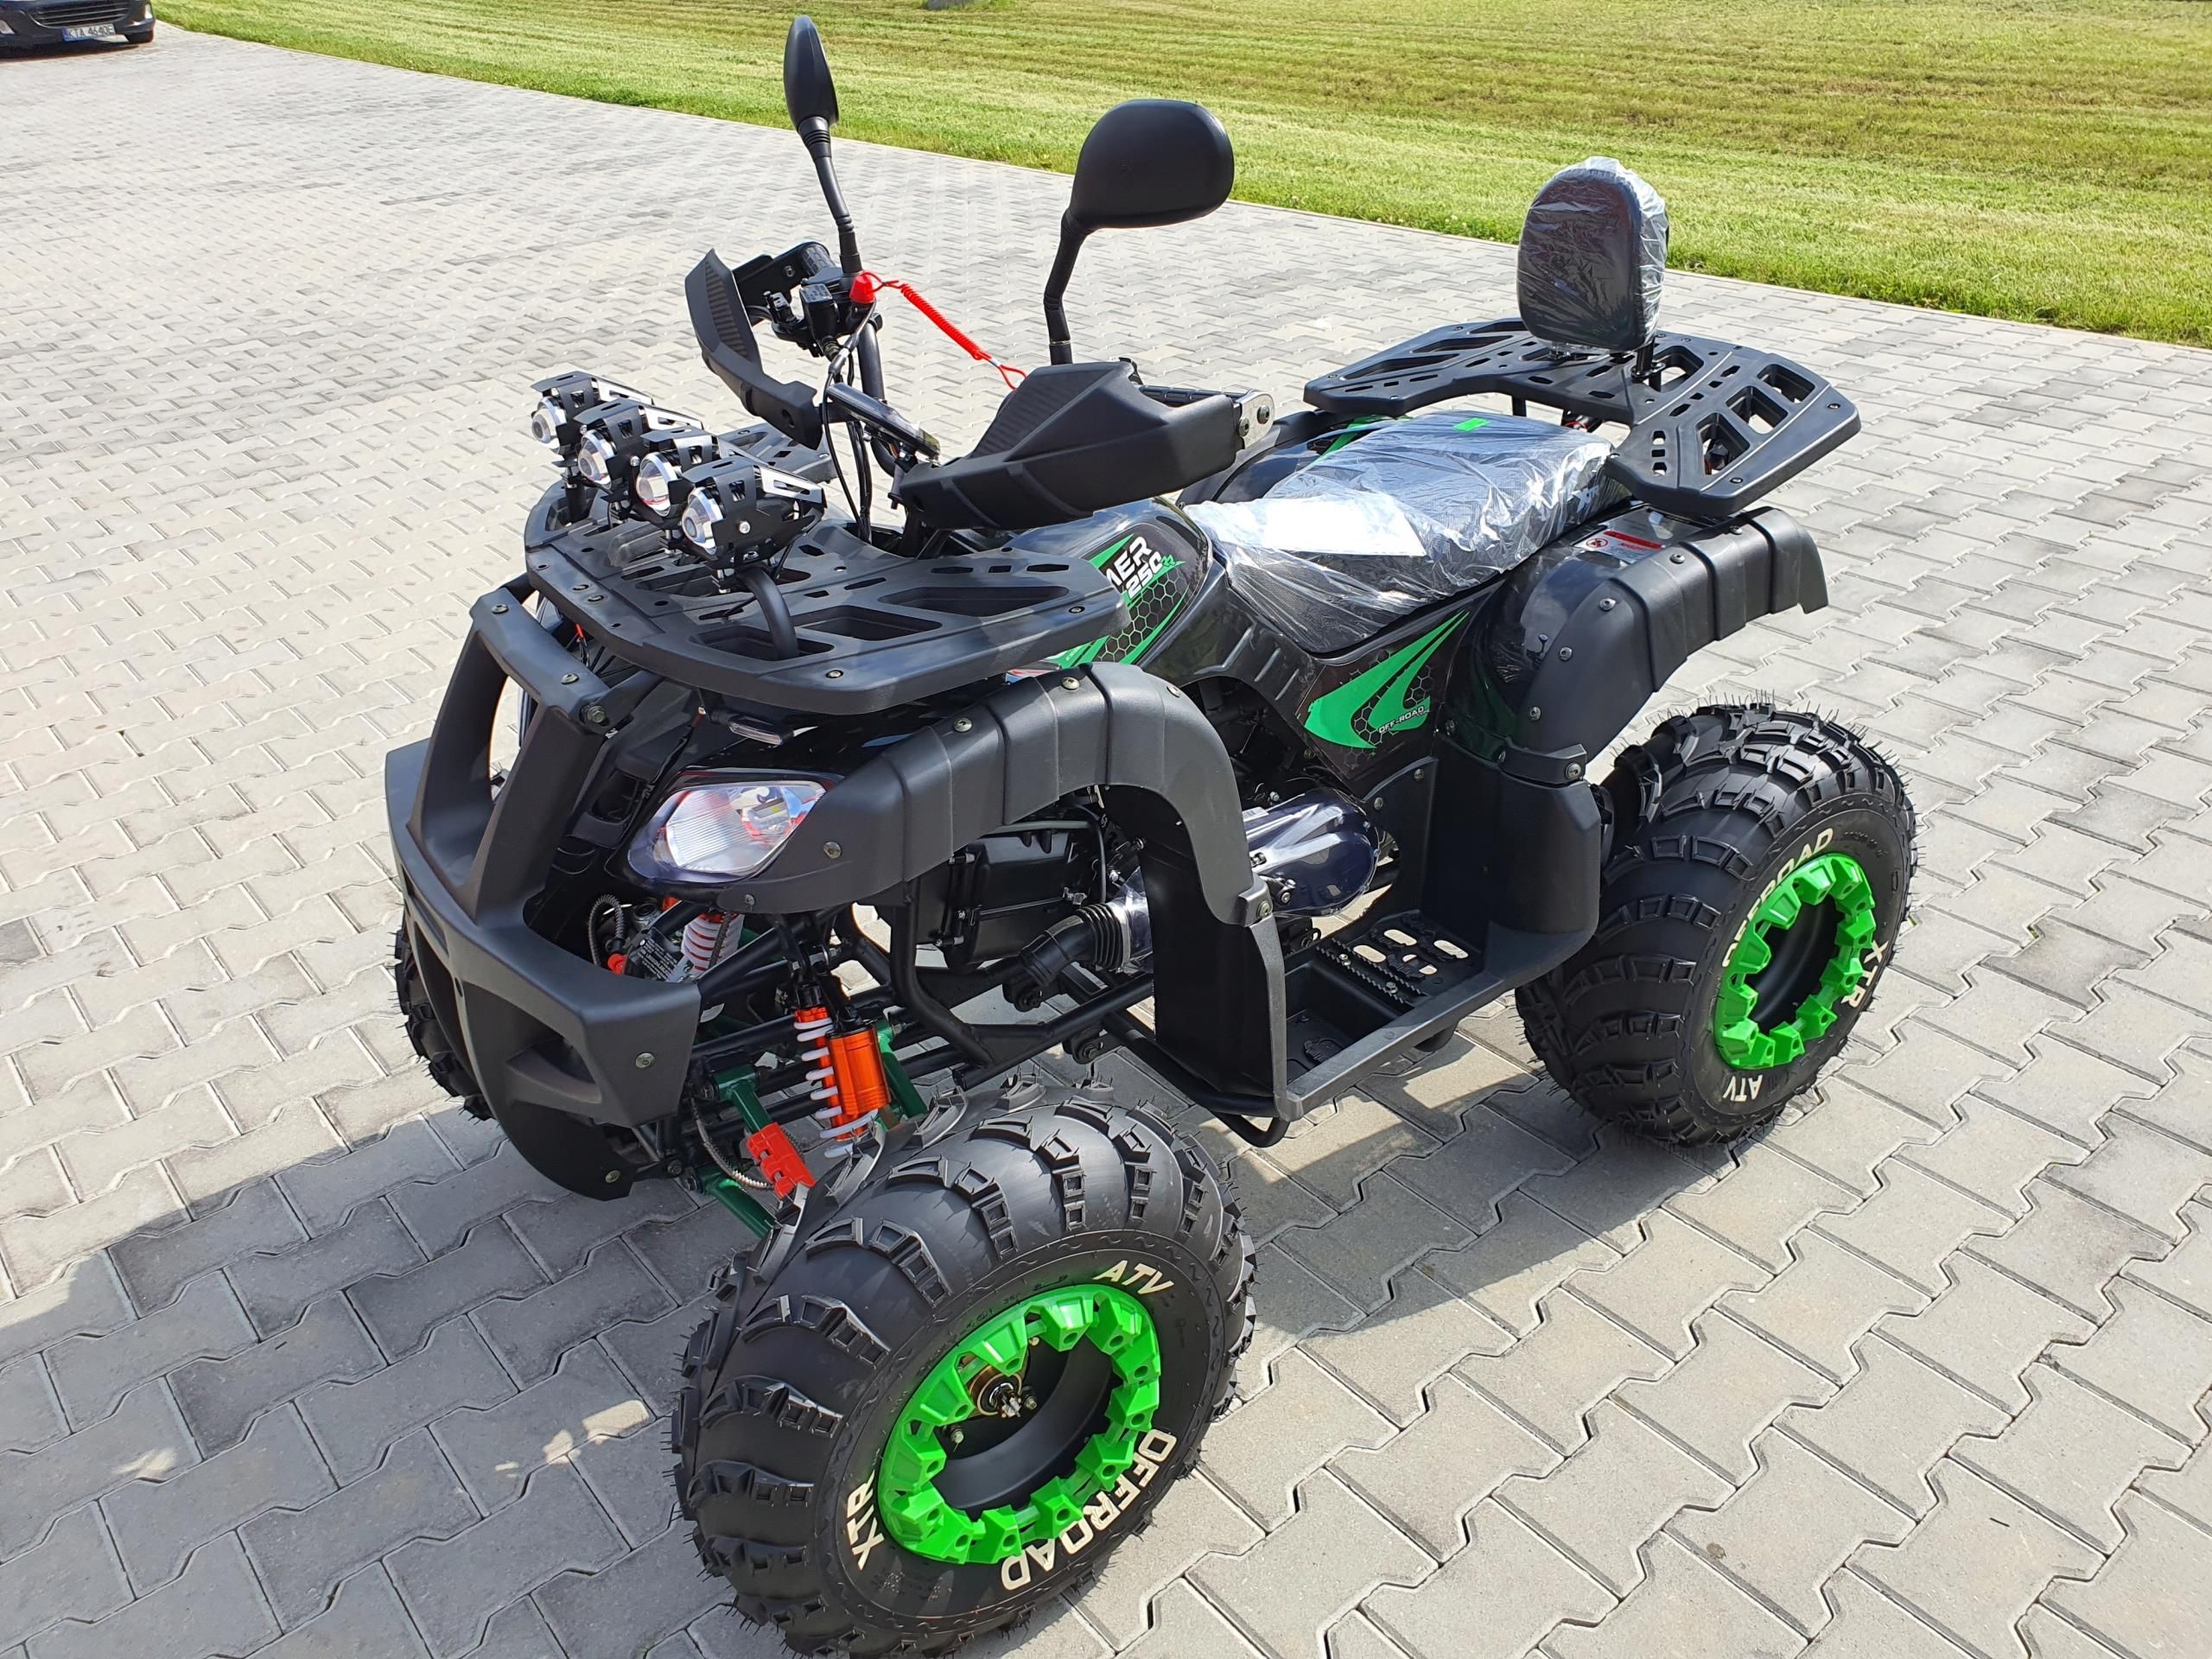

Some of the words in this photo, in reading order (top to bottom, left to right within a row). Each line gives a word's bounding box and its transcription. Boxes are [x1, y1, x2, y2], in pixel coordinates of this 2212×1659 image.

[1378, 705, 1425, 734] OFF-ROAD
[1840, 939, 1890, 1007] XTR
[1722, 1074, 1764, 1102] ATV
[1091, 1260, 1175, 1295] ATV
[846, 1469, 885, 1571] XTR
[1001, 1427, 1178, 1591] OFFROAD
